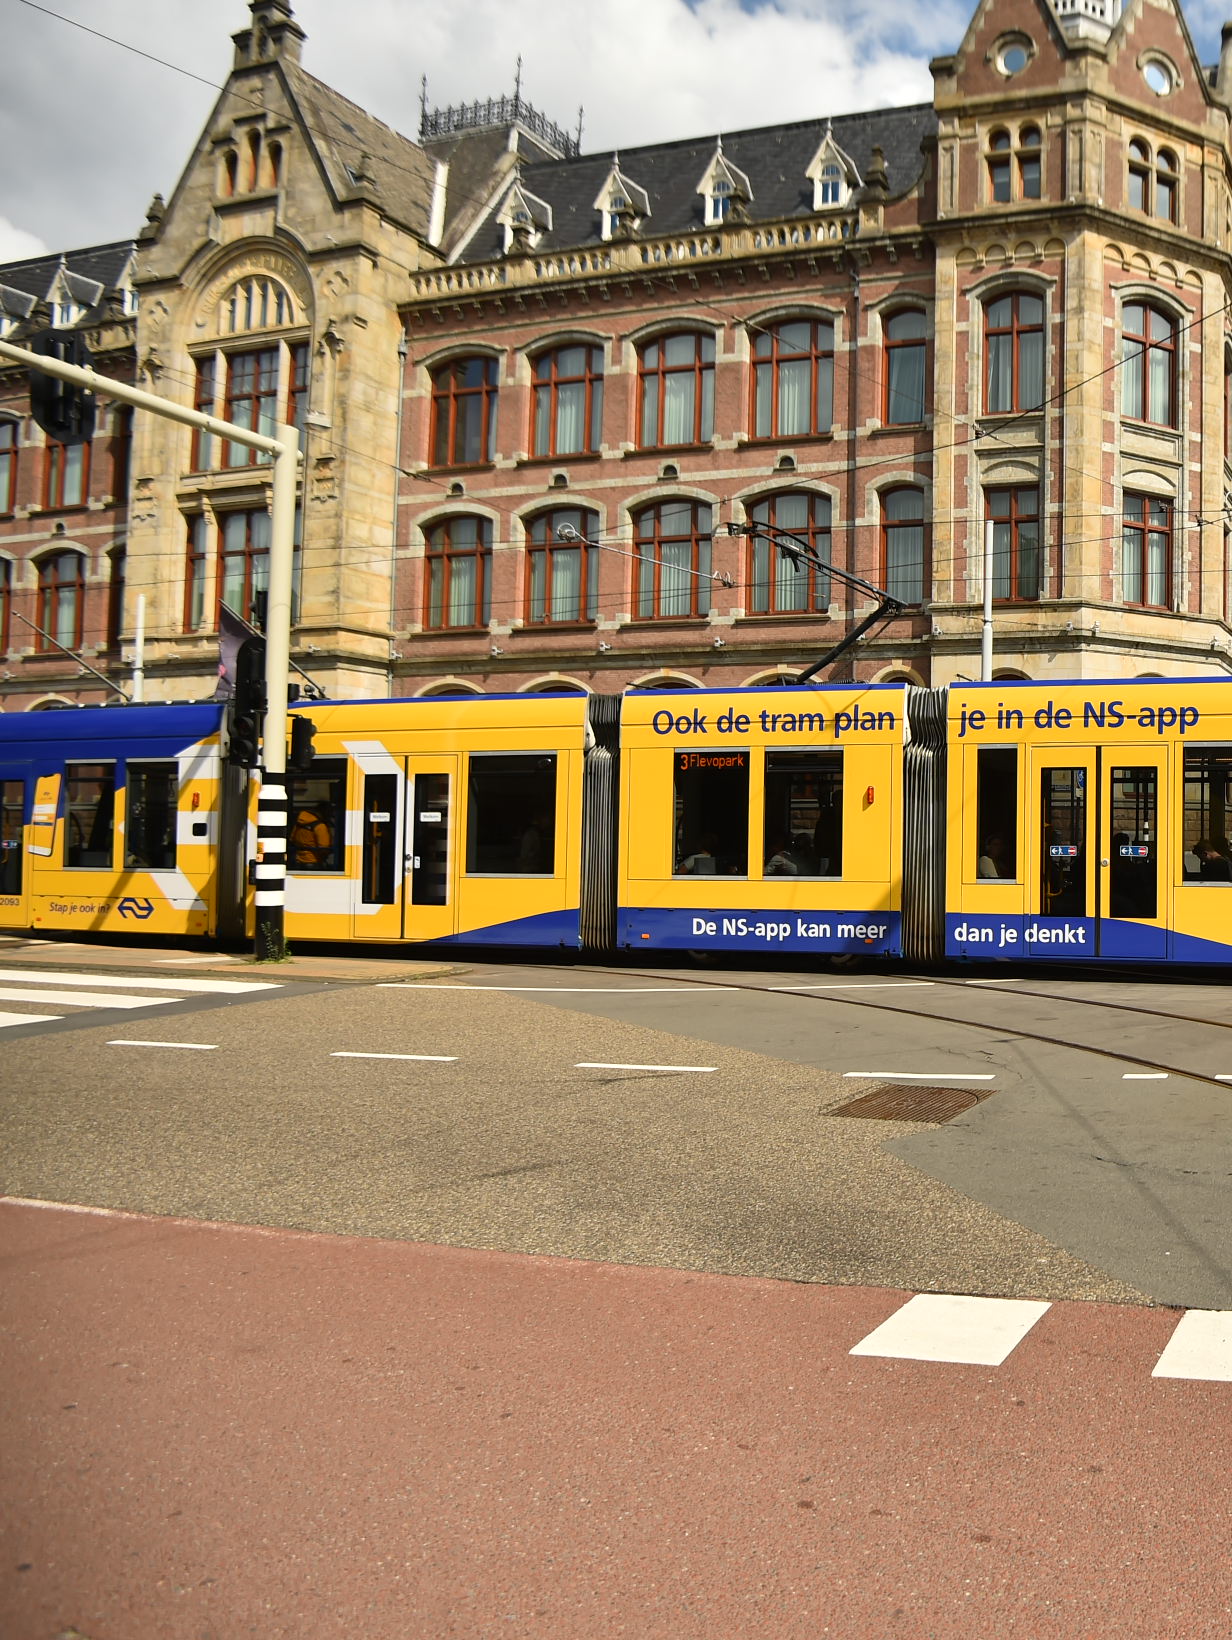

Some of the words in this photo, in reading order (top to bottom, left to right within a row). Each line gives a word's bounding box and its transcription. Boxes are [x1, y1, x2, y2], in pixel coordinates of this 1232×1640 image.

[653, 708, 708, 735] Ook
[717, 707, 750, 733] de
[759, 709, 825, 732] tram
[834, 704, 895, 738] plan
[958, 703, 986, 737] je
[997, 702, 1023, 729] in
[1034, 701, 1073, 729] de
[1083, 701, 1200, 735] NS-app
[681, 754, 689, 770] 3
[690, 753, 744, 769] Flevopark
[50, 902, 68, 914] Stap
[69, 902, 77, 915] je
[80, 902, 96, 913] ook
[98, 903, 110, 913] in?
[692, 918, 717, 936] De
[723, 918, 791, 941] NS-app
[797, 918, 831, 938] kan
[838, 924, 887, 939] meer
[954, 922, 993, 942] dan
[999, 923, 1018, 947] je
[1024, 923, 1086, 944] denkt
